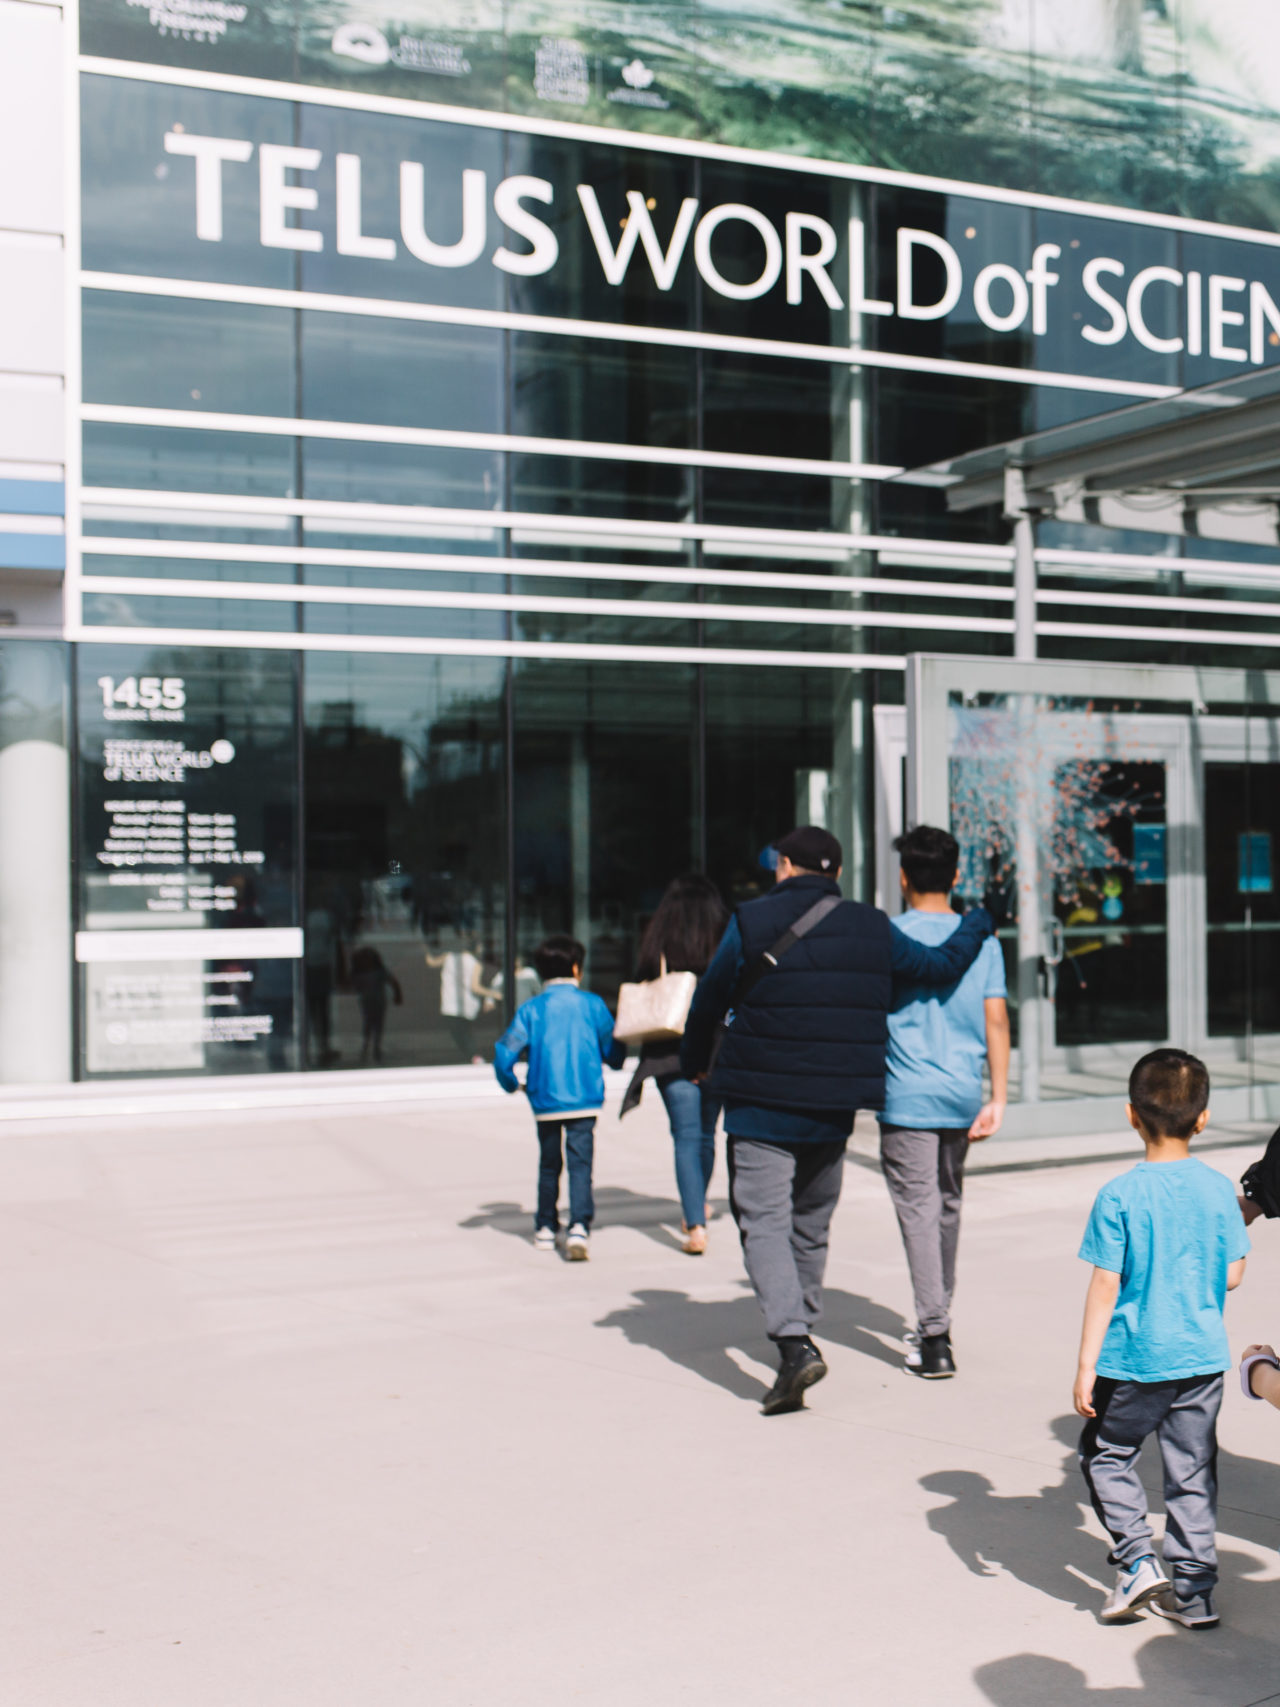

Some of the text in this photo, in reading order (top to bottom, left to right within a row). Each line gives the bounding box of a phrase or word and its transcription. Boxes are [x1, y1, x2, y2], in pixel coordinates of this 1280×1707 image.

[163, 130, 560, 276] TELUS
[576, 184, 963, 321] WORLD
[972, 243, 1062, 336] of
[97, 676, 186, 710] 1455
[104, 749, 214, 769] TELUS WORLD
[122, 766, 186, 782] SCIENCE
